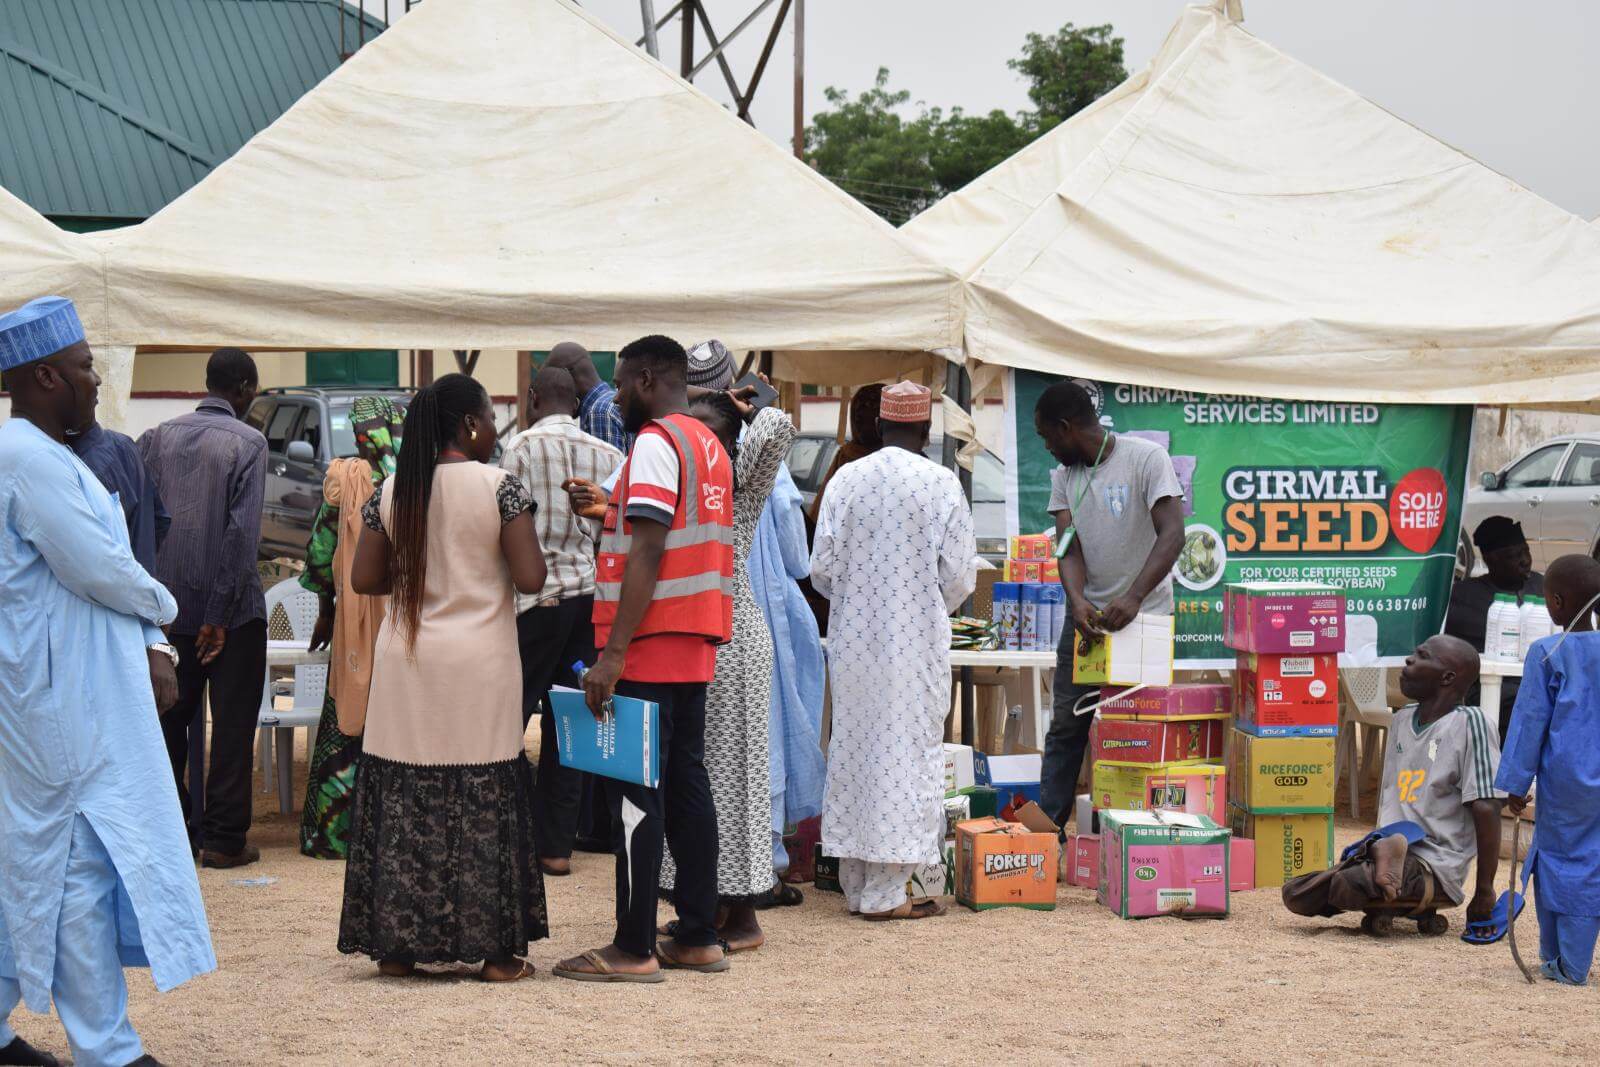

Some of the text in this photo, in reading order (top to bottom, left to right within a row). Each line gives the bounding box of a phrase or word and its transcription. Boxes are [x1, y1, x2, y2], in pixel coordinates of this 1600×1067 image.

[1115, 383, 1200, 403] GIRMAL
[1183, 403, 1379, 424] SERVICES LIMITED
[1225, 470, 1387, 500] GIRMAL
[1398, 492, 1443, 511] SOLD
[1226, 502, 1389, 552] SEED
[1400, 511, 1440, 529] HERE
[1240, 566, 1397, 578] FOR YOUR CERTIFIED SEEDS
[1173, 634, 1213, 642] ROPCOM
[1259, 764, 1323, 775] RICEFORCE
[1275, 776, 1306, 786] GOLD
[1294, 839, 1303, 868] GOLD
[985, 854, 1045, 874] FORCE UP
